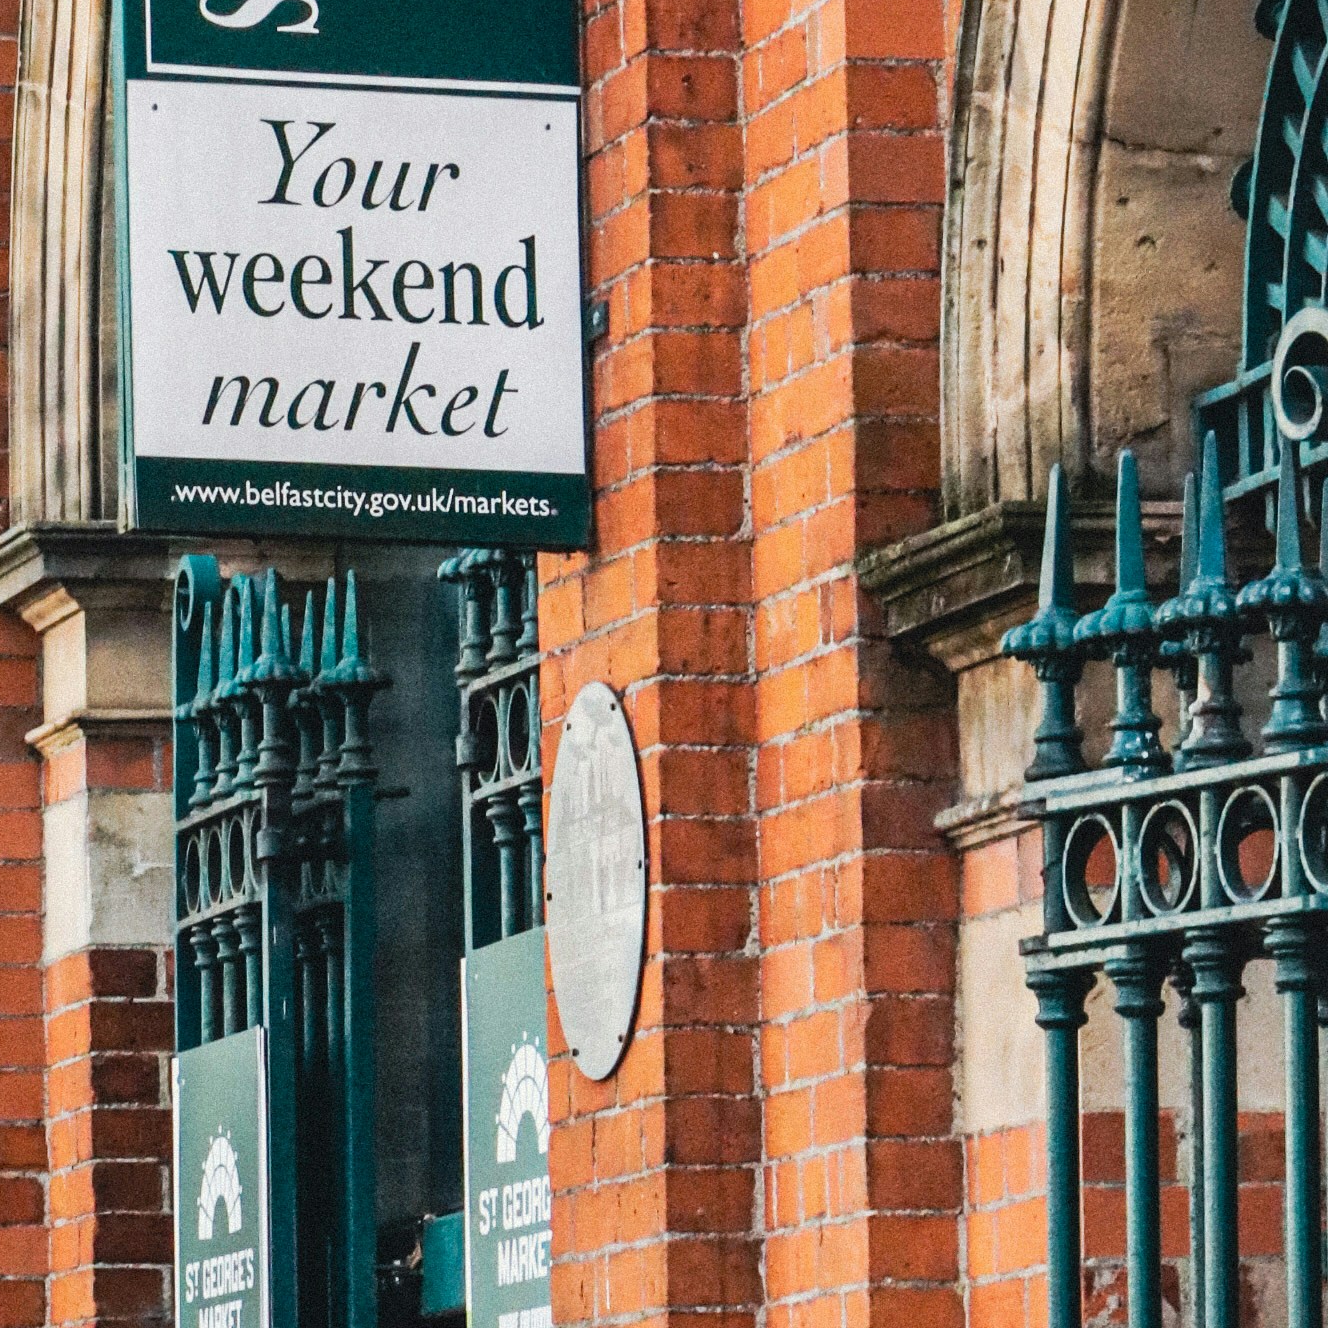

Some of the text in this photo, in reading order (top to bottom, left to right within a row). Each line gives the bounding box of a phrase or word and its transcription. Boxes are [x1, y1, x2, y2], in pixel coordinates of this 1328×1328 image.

[258, 118, 460, 212] Your
[167, 225, 545, 331] weekend
[201, 341, 519, 439] market
[175, 480, 550, 517] www.belfastcity.gov.uk/markets
[203, 1247, 255, 1300] GEORGE'S
